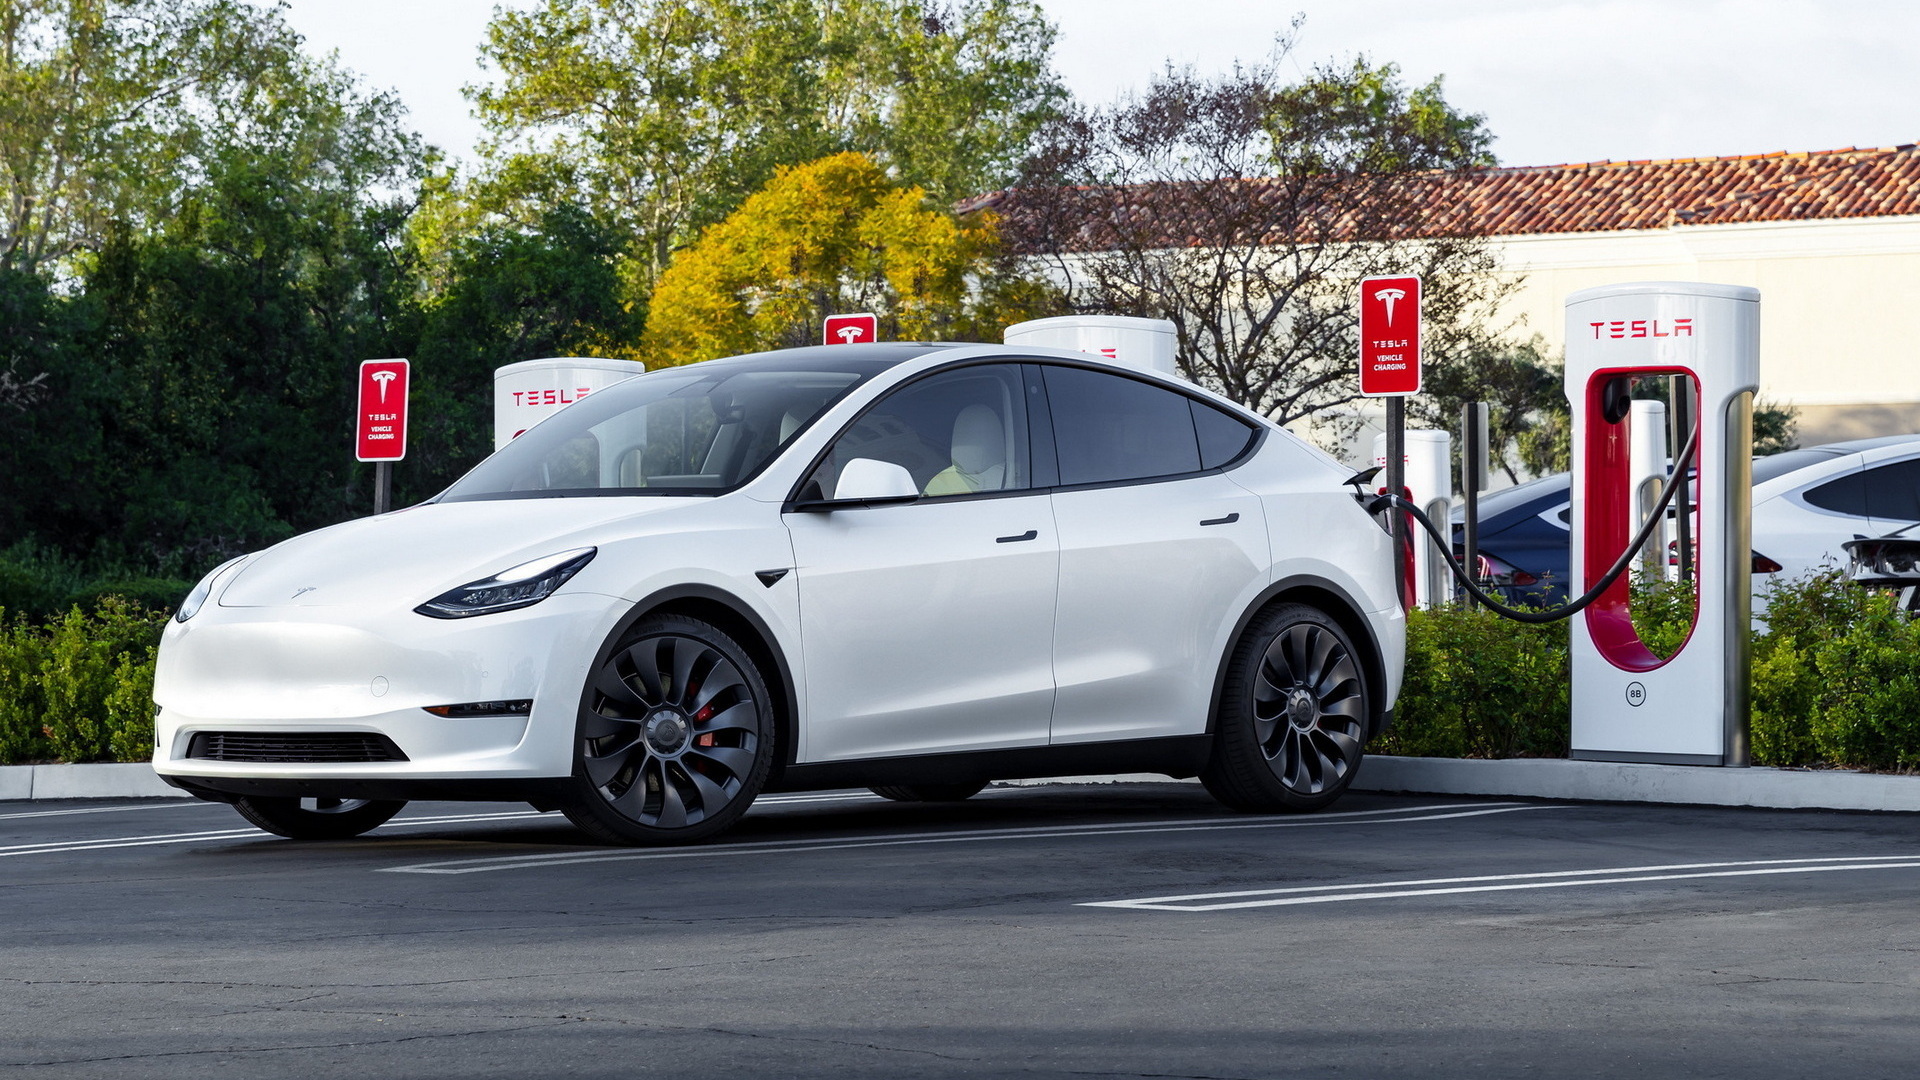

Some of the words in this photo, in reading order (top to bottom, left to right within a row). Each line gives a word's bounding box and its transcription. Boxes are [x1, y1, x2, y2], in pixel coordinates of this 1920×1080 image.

[1590, 319, 1692, 340] TESLA
[1373, 339, 1408, 348] TESLA
[1377, 354, 1403, 362] VEHICLE
[1374, 363, 1406, 371] CHARGING
[368, 413, 397, 421] TESLA
[1630, 689, 1641, 698] 8B
